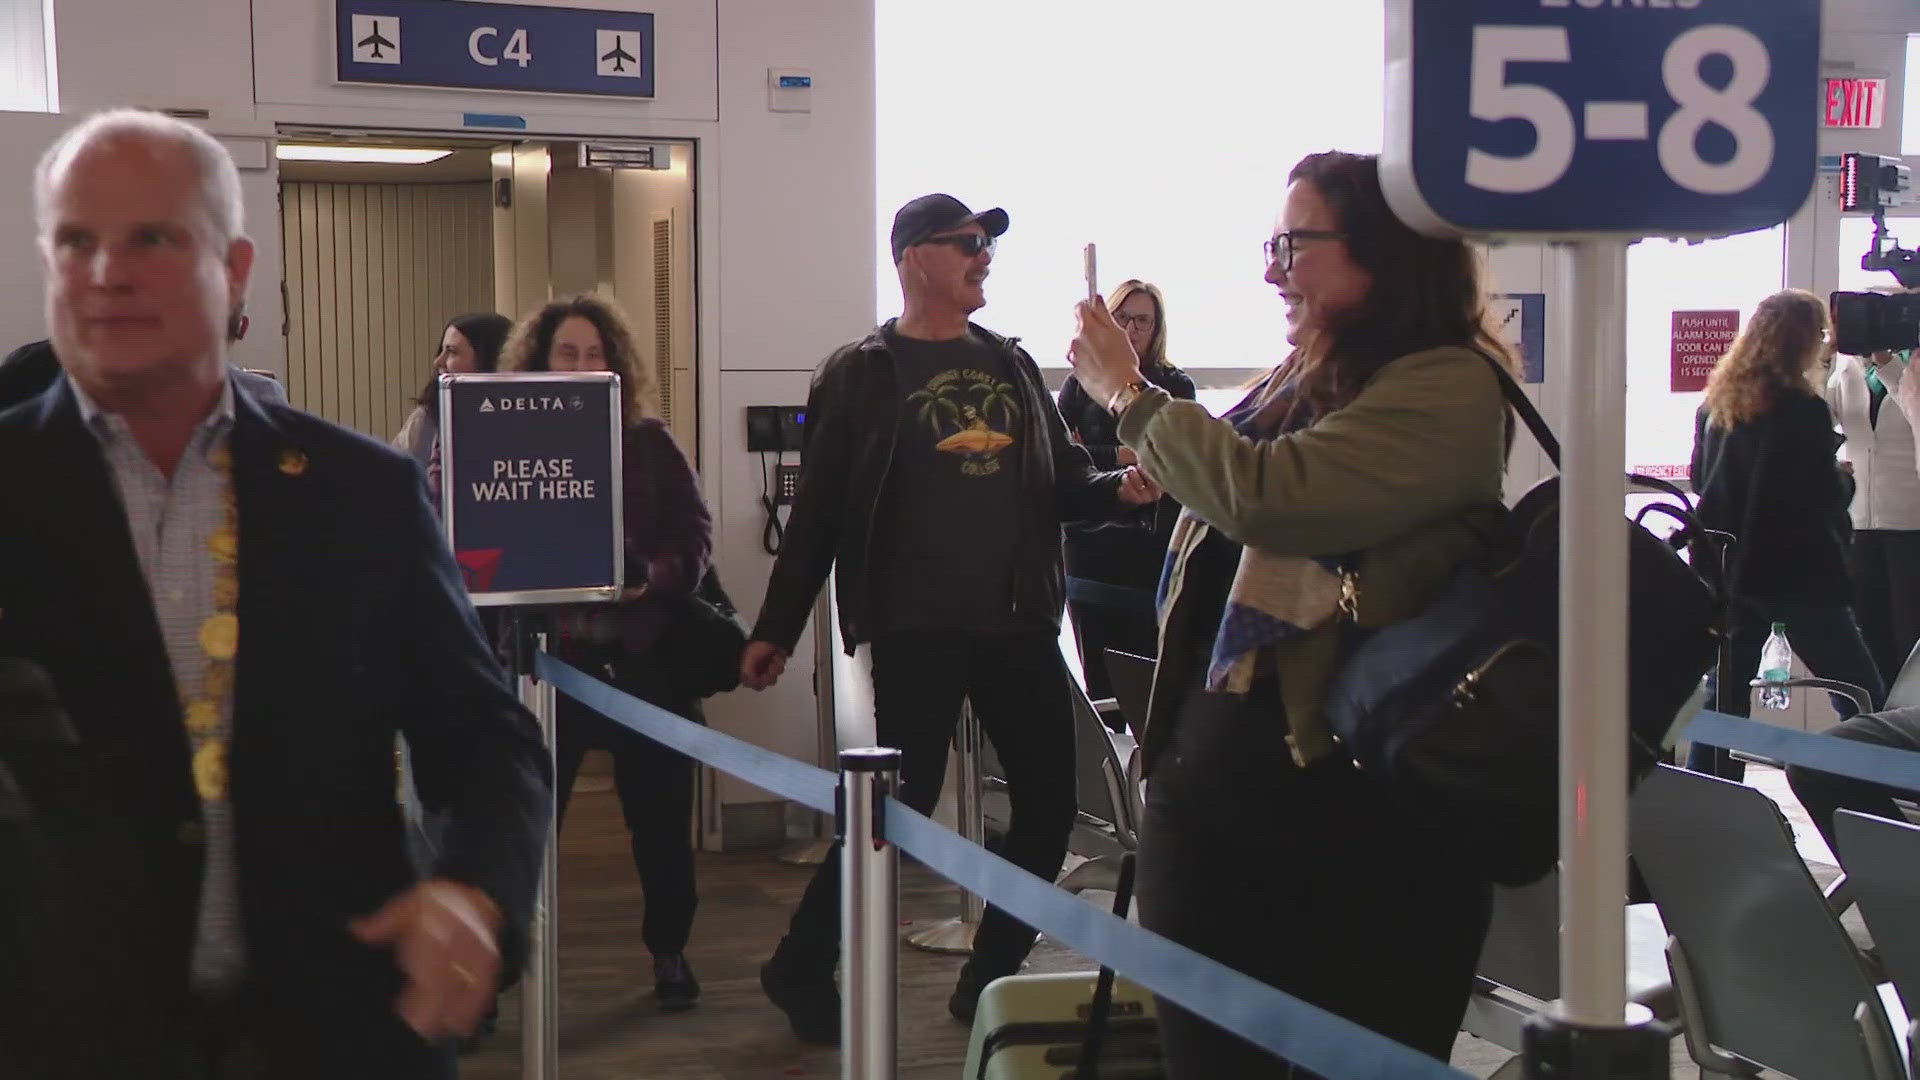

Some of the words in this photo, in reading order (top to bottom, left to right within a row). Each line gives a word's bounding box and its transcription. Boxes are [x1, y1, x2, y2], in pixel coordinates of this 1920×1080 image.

[468, 26, 532, 68] C4
[1464, 24, 1775, 195] 5-8
[1825, 79, 1877, 126] EXIT
[1681, 318, 1704, 328] PUSH
[1705, 318, 1729, 328] UNTIL
[1673, 331, 1704, 340] ALARM
[1676, 343, 1702, 352] DOOR
[1703, 343, 1722, 352] CAN
[1682, 355, 1716, 364] OPENED
[1681, 367, 1690, 376] 15
[500, 397, 564, 411] DELTA
[493, 459, 574, 480] PLEASE
[472, 481, 534, 502] WAIT
[539, 480, 596, 501] HERE
